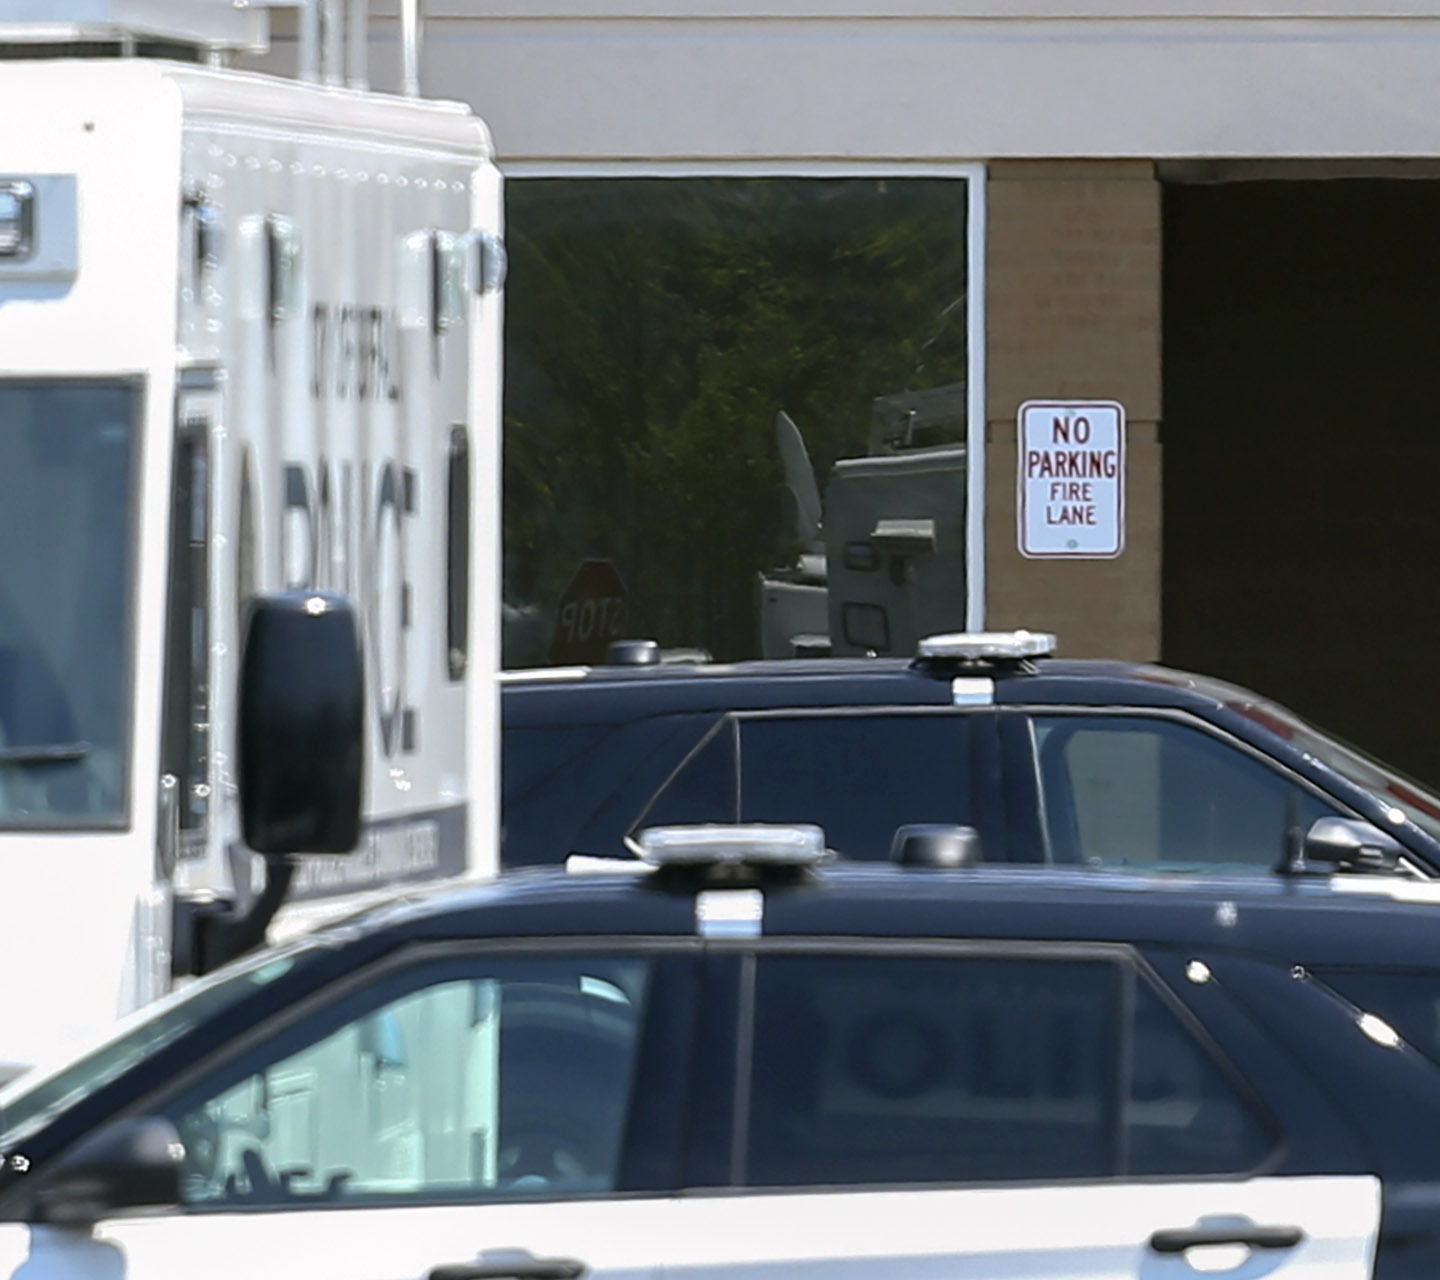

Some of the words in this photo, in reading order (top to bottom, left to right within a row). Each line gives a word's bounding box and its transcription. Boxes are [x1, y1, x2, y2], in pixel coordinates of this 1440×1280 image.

[1053, 417, 1090, 444] NO
[1028, 450, 1116, 479] PARKING
[1050, 482, 1093, 501] FIRE
[1046, 505, 1097, 525] LANE
